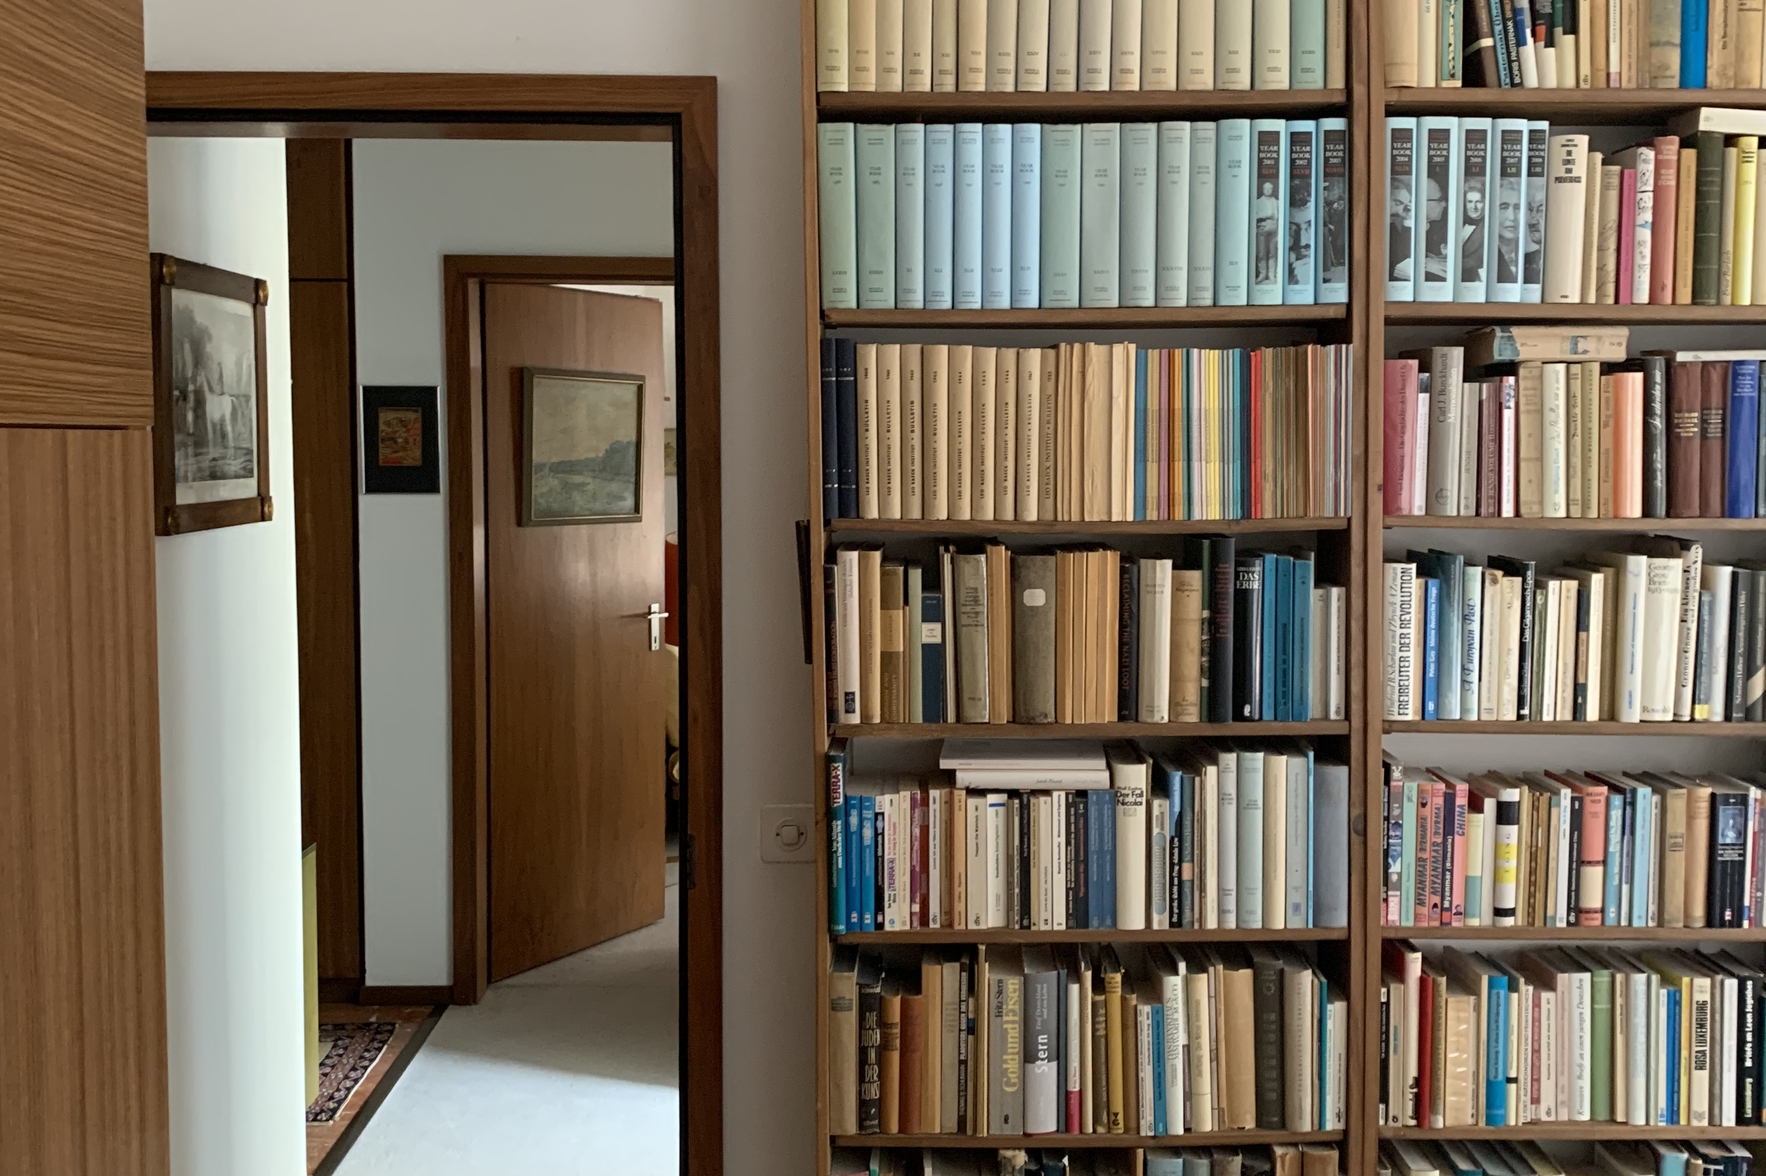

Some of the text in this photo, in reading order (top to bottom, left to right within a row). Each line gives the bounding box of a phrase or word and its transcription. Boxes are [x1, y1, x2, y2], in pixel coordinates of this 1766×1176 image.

[1498, 29, 1509, 86] Pasternak
[1507, 20, 1521, 83] BORIS PASTERNAK
[1438, 353, 1447, 396] Burckhardt
[1437, 406, 1446, 422] Carl
[1236, 580, 1261, 589] ERBE
[1239, 572, 1260, 580] DAS
[1681, 577, 1691, 606] kleines
[1465, 598, 1475, 623] Past
[1681, 608, 1689, 624] Ein
[1122, 574, 1130, 690] RECLAIMING THE NAZI LOOT
[1398, 567, 1413, 716] FREIBEUTER DER REVOLUTION
[1522, 629, 1530, 642] Das
[1463, 629, 1475, 675] European
[1387, 630, 1397, 716] Winfried und
[831, 763, 841, 807] TERRA-X
[1131, 790, 1144, 798] Fall
[1117, 798, 1143, 806] Nicolai
[1456, 804, 1466, 836] CHINA
[1431, 803, 1442, 896] MYANMAR (BURMA)
[887, 859, 895, 889] TERRA-X
[1417, 857, 1428, 907] MYANMAR
[994, 979, 1003, 1018] Fritz Stern
[866, 1011, 877, 1028] DIE
[1002, 979, 1019, 1092] Gold und Eisen
[1695, 1000, 1708, 1070] ROSA LUXEMBURG
[861, 1029, 880, 1047] JUDEN
[1035, 1035, 1048, 1073] Stern
[1744, 980, 1754, 1118] Luxemburg Briefe an Leon Jogiches
[868, 1047, 876, 1064] IN
[865, 1065, 879, 1082] DER
[862, 1081, 880, 1100] KUNST
